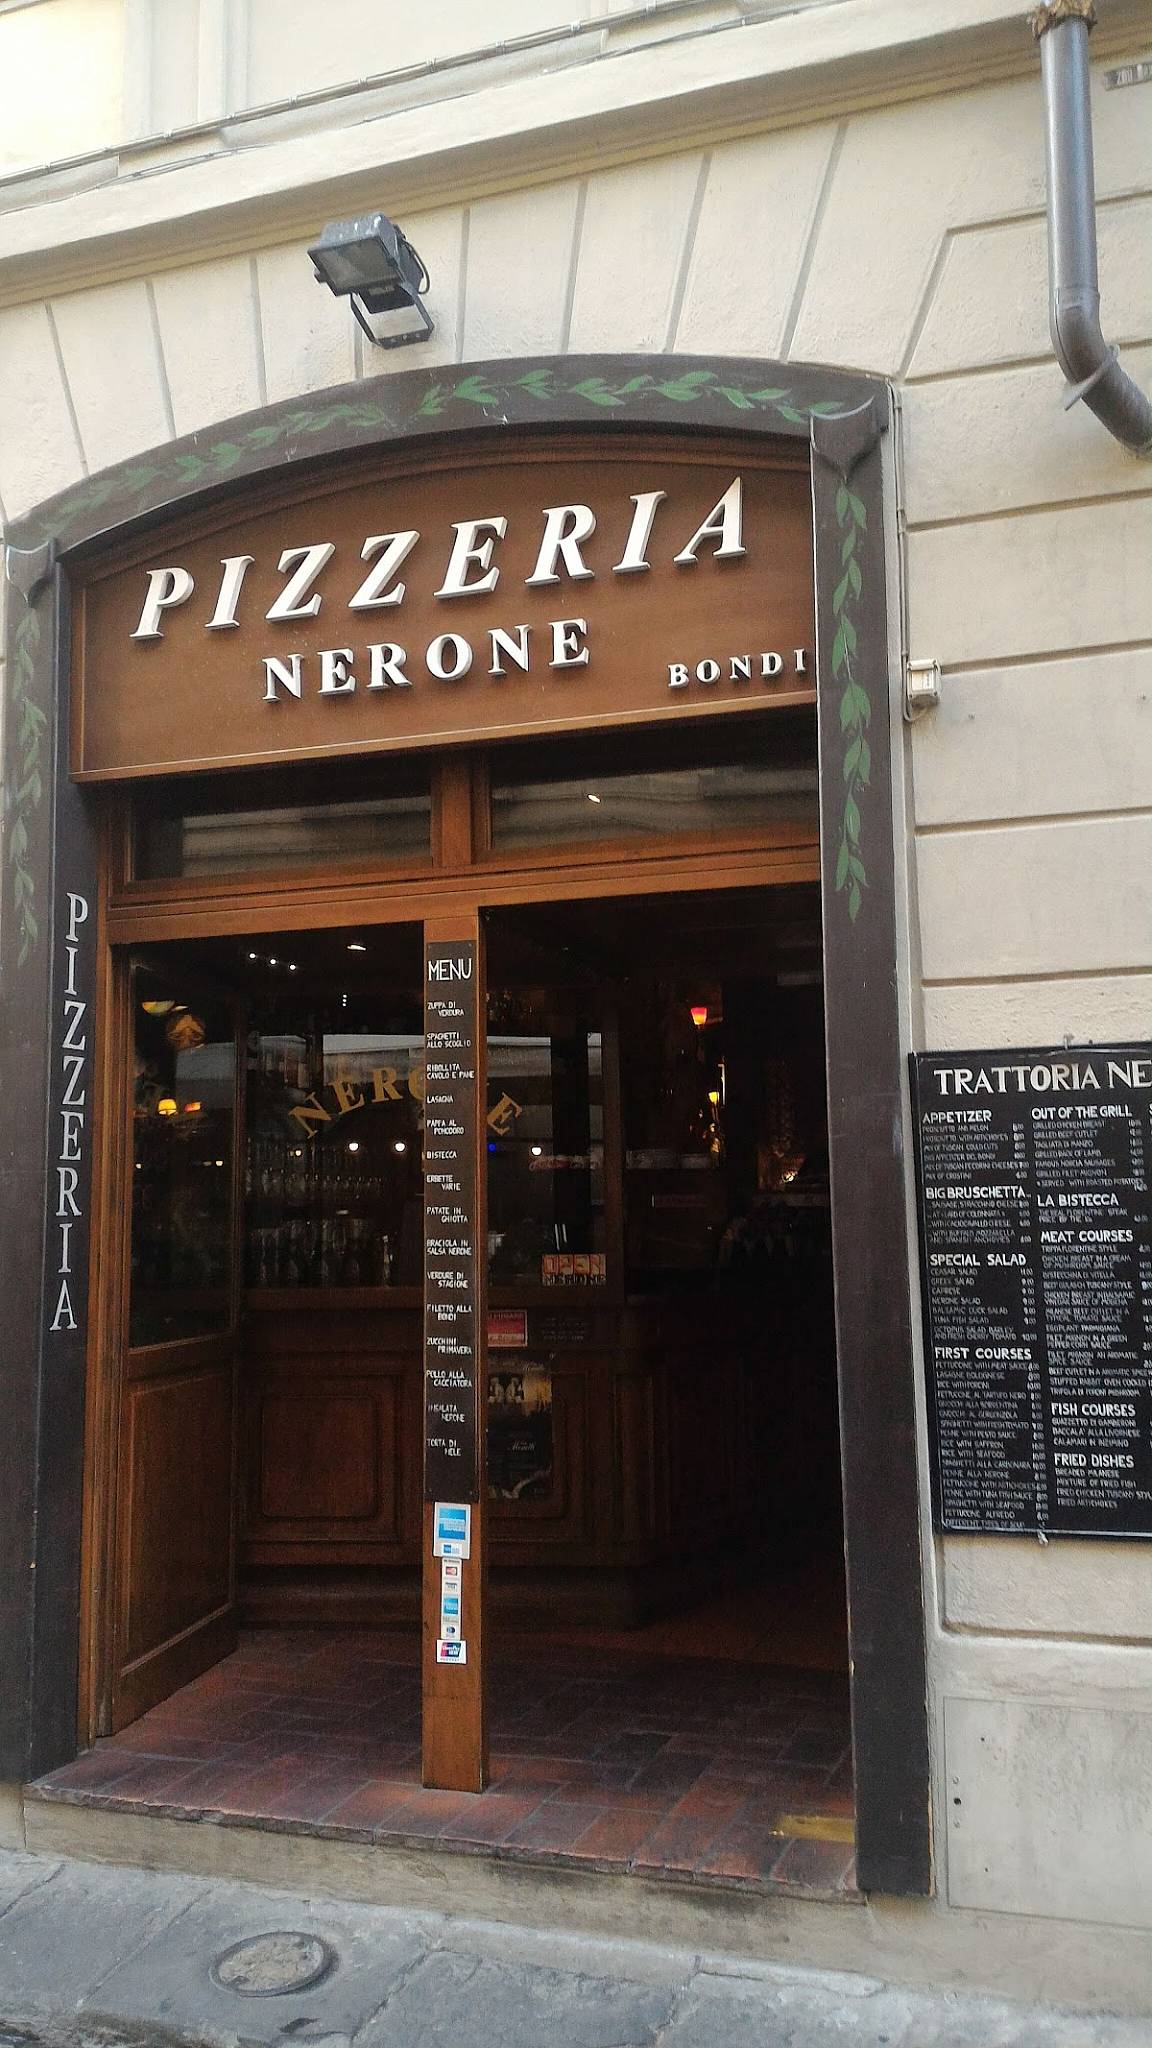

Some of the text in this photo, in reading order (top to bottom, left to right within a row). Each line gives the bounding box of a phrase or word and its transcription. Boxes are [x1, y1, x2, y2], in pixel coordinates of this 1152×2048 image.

[130, 476, 748, 641] PIZZERIA
[261, 618, 591, 703] NERONE
[667, 648, 807, 689] BONDI
[428, 958, 472, 981] MENU
[427, 1001, 456, 1010] ZUPPA DI
[438, 1009, 464, 1017] VERDURA
[427, 1040, 472, 1049] ALLO SCOGLIO
[427, 1064, 460, 1072] RIBOLLITA
[427, 1072, 449, 1080] CAVOLO
[934, 1063, 1101, 1095] TRATTORIA
[49, 892, 89, 1332] PIZZERIA
[1031, 1107, 1056, 1120] OUT
[1058, 1106, 1073, 1119] OF
[1075, 1105, 1098, 1119] THE
[1099, 1104, 1133, 1118] GRILL
[922, 1110, 992, 1124] APPETIZER
[448, 1119, 457, 1127] AL
[427, 1151, 457, 1160] BISTECCA
[441, 1182, 461, 1191] VARIE
[926, 1187, 945, 1199] BIG
[1037, 1193, 1119, 1207] LA BISTECCA
[427, 1207, 461, 1215] PATATE IN
[441, 1215, 468, 1223] GHIOTTA
[1040, 1230, 1134, 1243] MEAT COURSES
[427, 1247, 472, 1256] SALSA NERONE
[930, 1253, 1027, 1267] SPECIAL SALAD
[427, 1271, 454, 1280] VERDURE
[438, 1280, 468, 1288] STAGIONE
[427, 1304, 472, 1313] FILETTO ALLA
[427, 1337, 457, 1346] ZUCCHINI
[438, 1346, 472, 1355] PRIMAVERA
[935, 1347, 1032, 1360] FIRST COURSES
[426, 1370, 465, 1379] POLLO ALLA
[433, 1379, 472, 1388] CACCIATORA
[1051, 1402, 1078, 1416] FISH
[1081, 1403, 1136, 1417] COURSES
[1054, 1453, 1135, 1468] FRIED DISHES
